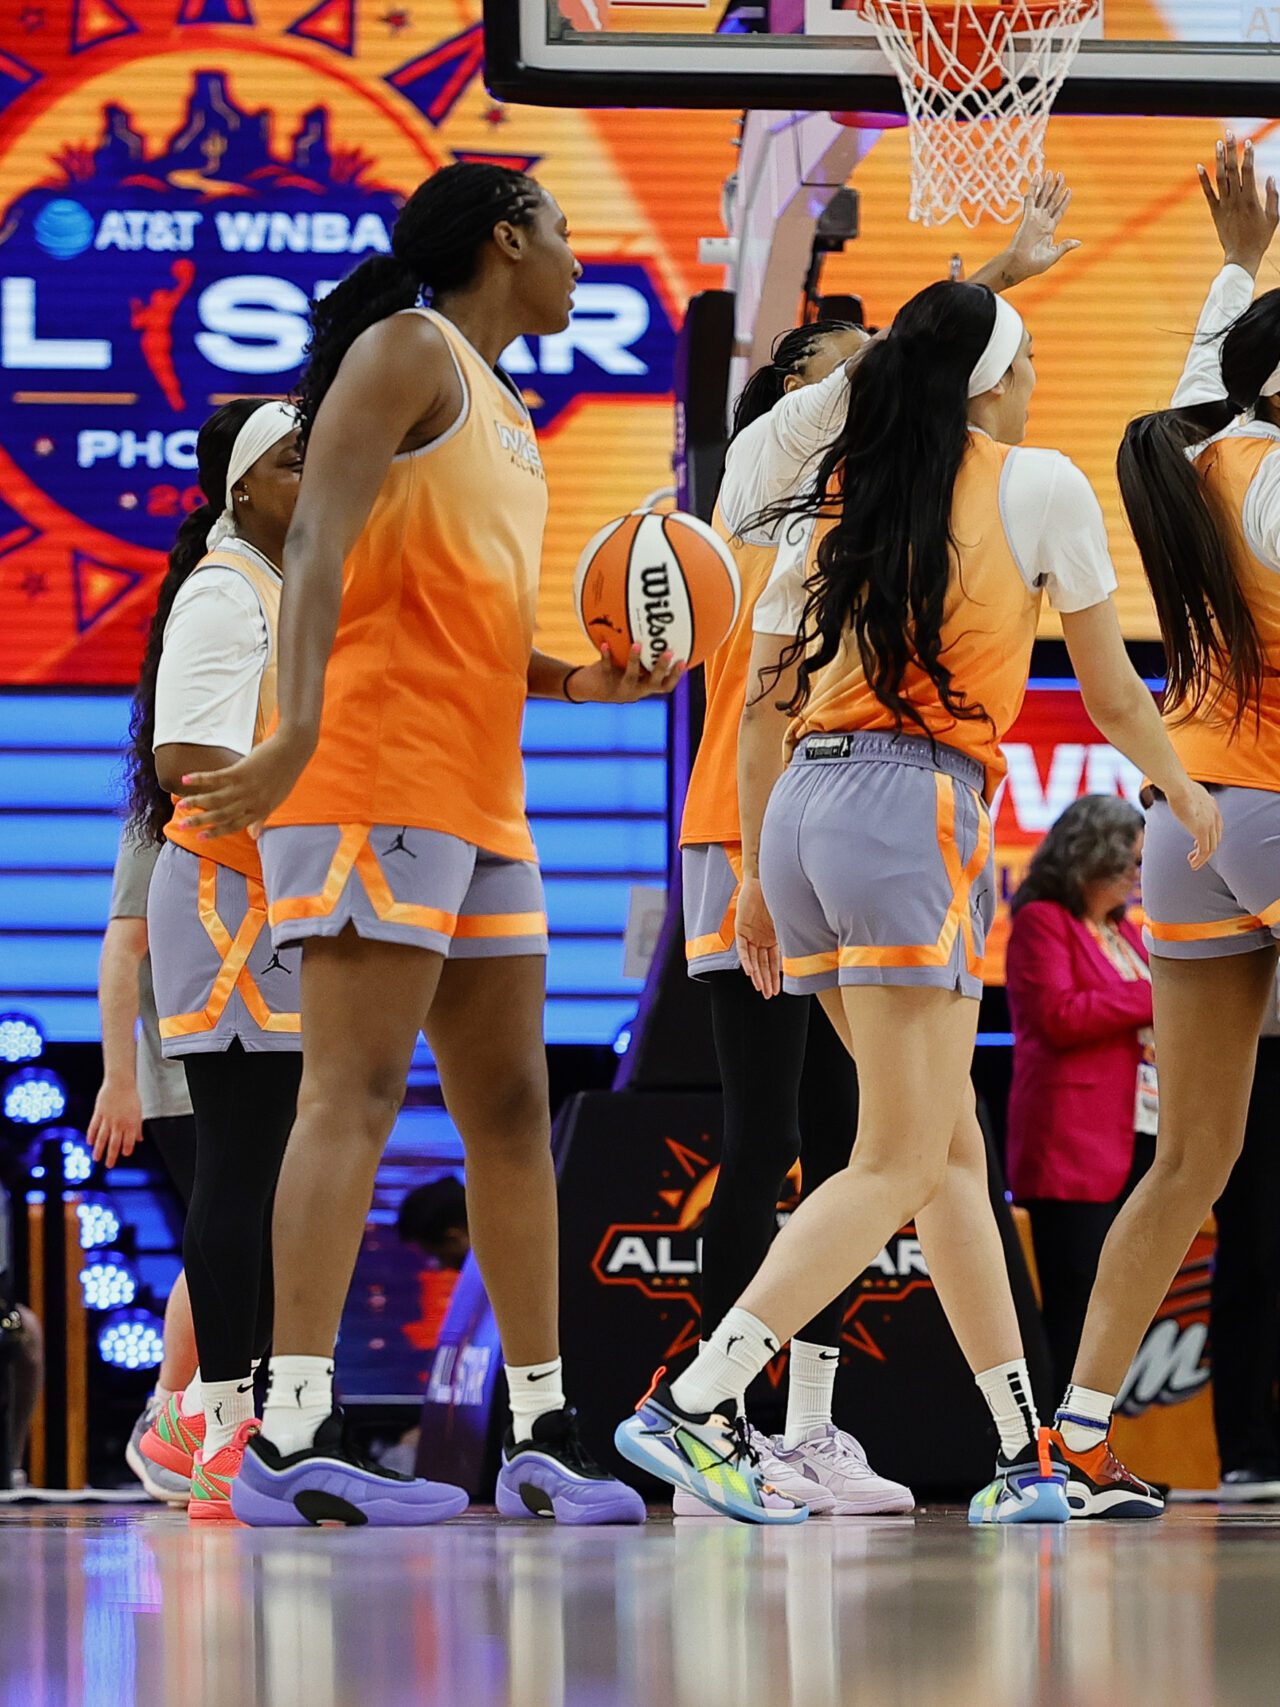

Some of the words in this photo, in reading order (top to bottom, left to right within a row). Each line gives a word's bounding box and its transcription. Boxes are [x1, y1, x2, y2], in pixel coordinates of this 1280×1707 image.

[95, 210, 202, 251] AT&T
[215, 212, 392, 253] WNBA
[606, 1236, 703, 1273] AL
